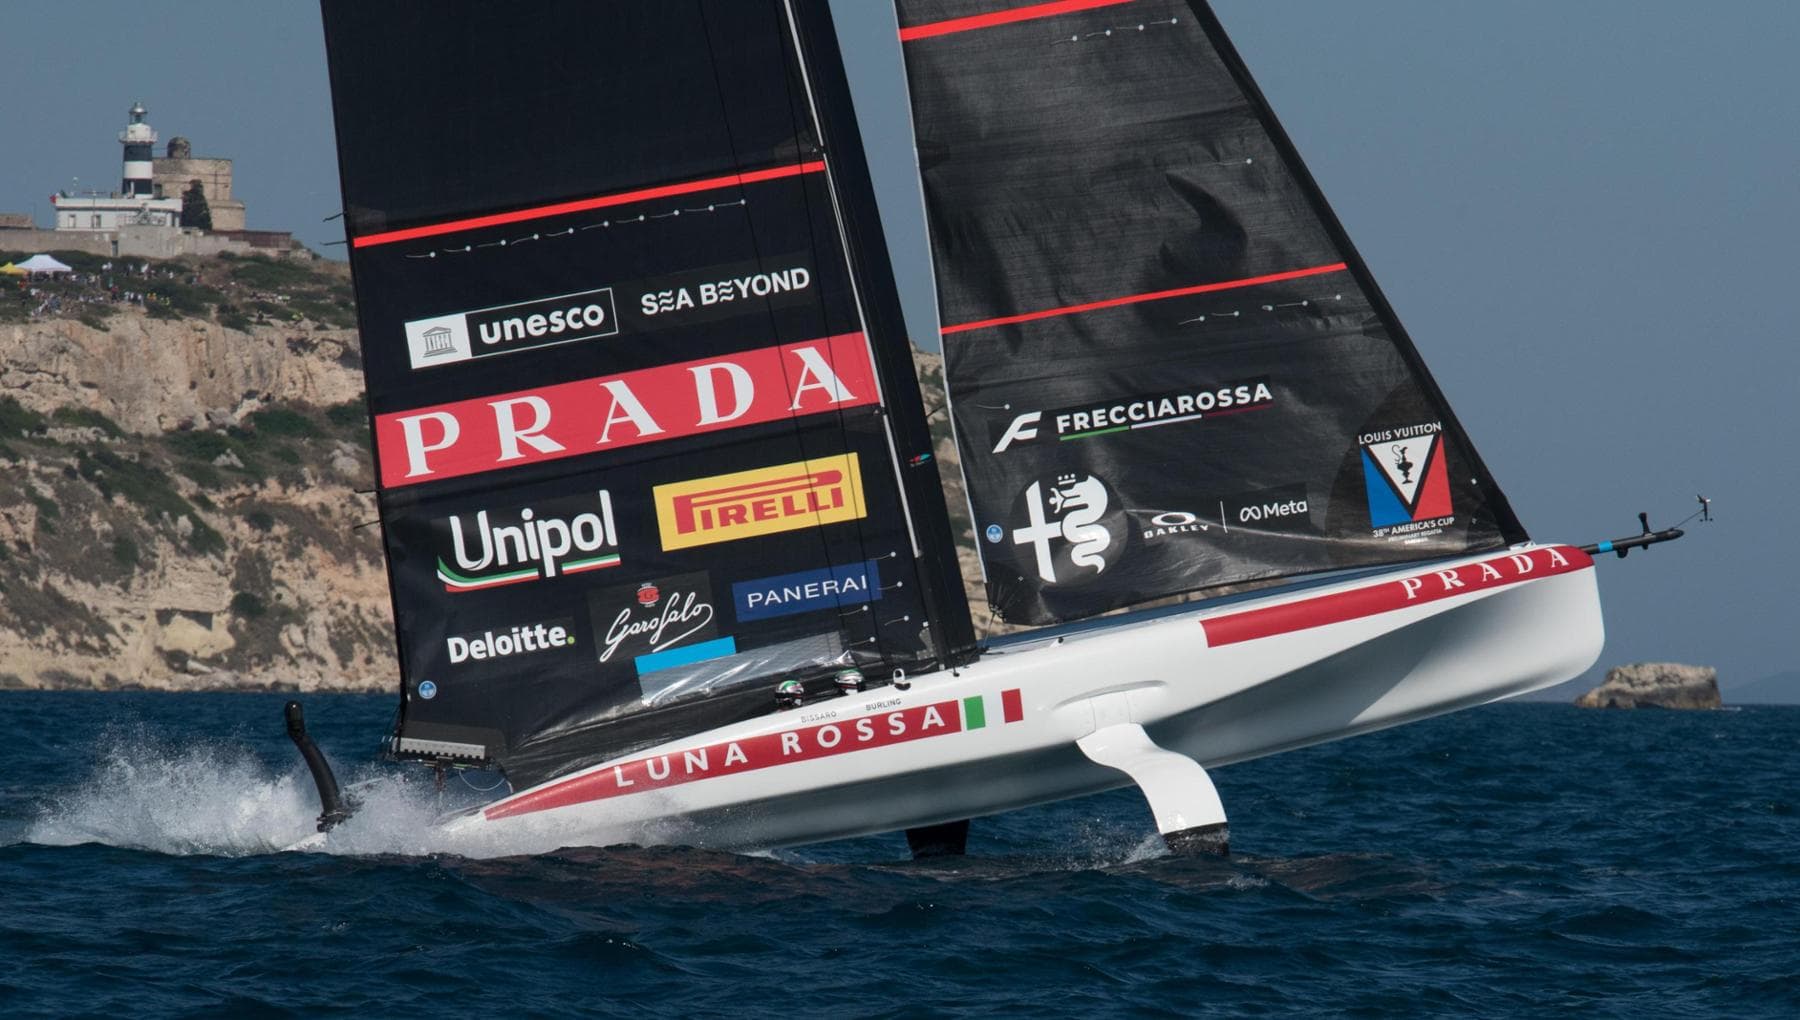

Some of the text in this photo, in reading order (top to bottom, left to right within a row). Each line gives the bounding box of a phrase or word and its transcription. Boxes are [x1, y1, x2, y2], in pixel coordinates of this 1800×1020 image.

[479, 304, 605, 344] unesco
[396, 346, 858, 478] PRADA
[1056, 383, 1273, 434] FRECCIAROSSA
[1358, 421, 1443, 445] LOUIS VUITTON
[672, 469, 844, 535] PIRELLI
[1264, 500, 1309, 520] Meta
[449, 489, 618, 578] Unipol
[1143, 524, 1210, 539] OAKLEY
[1391, 519, 1436, 535] AMERICA'S
[1437, 516, 1455, 527] CUP
[747, 575, 869, 609] PANERAI
[1400, 547, 1569, 600] PRADA
[447, 623, 576, 664] Deloitte.
[600, 591, 713, 663] Garofalo
[801, 710, 837, 723] BISSARO
[865, 698, 902, 711] BURLING
[613, 704, 945, 787] LUNA ROSSA
